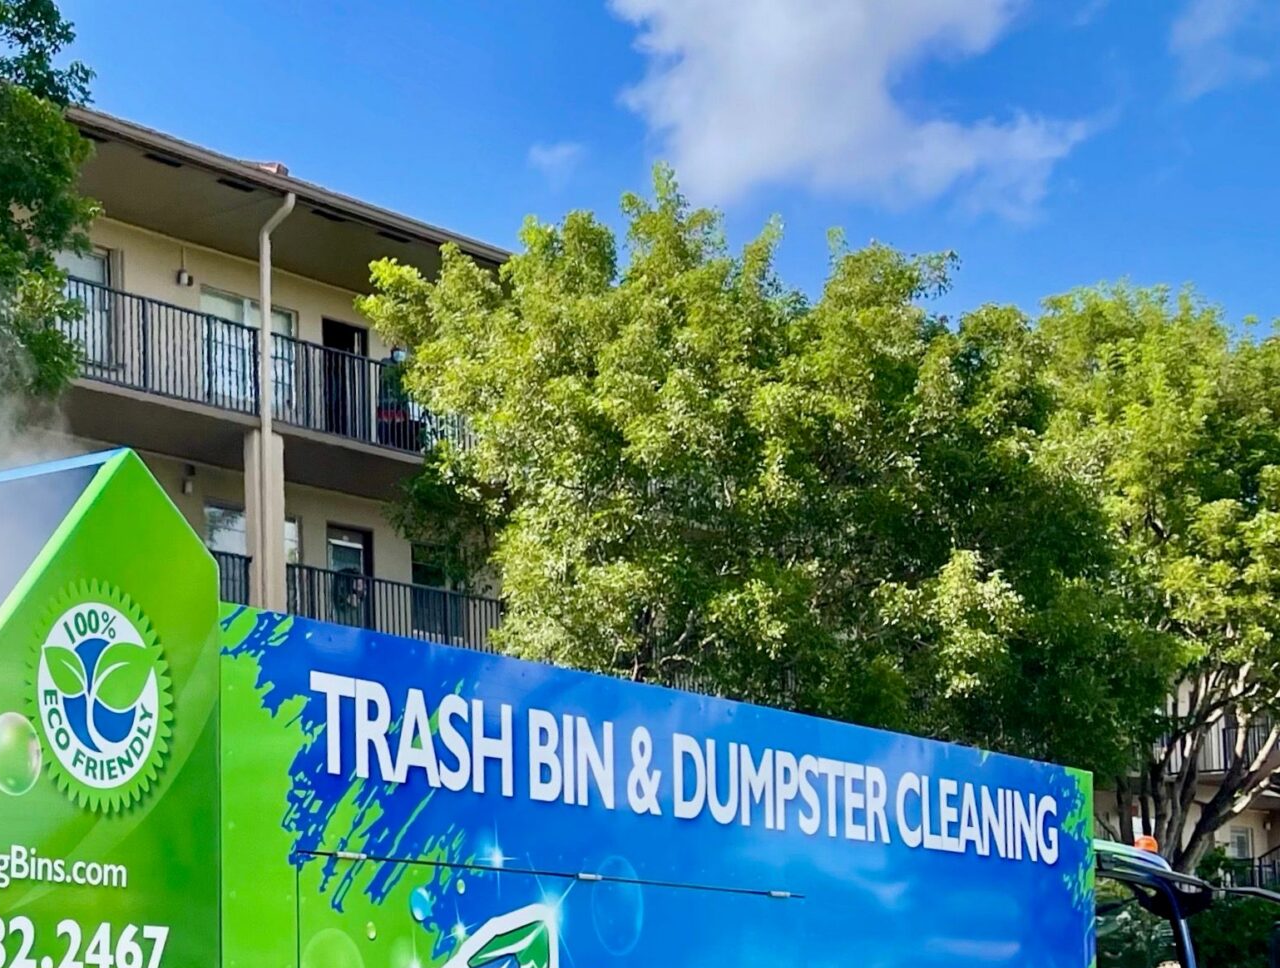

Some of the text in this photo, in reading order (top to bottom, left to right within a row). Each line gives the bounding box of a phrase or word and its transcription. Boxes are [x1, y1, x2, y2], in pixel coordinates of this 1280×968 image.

[63, 609, 117, 645] 100%
[43, 689, 154, 781] ECO FRIENDLY
[310, 670, 1059, 865] TRASH BIN & DUMPSTER CLEANING
